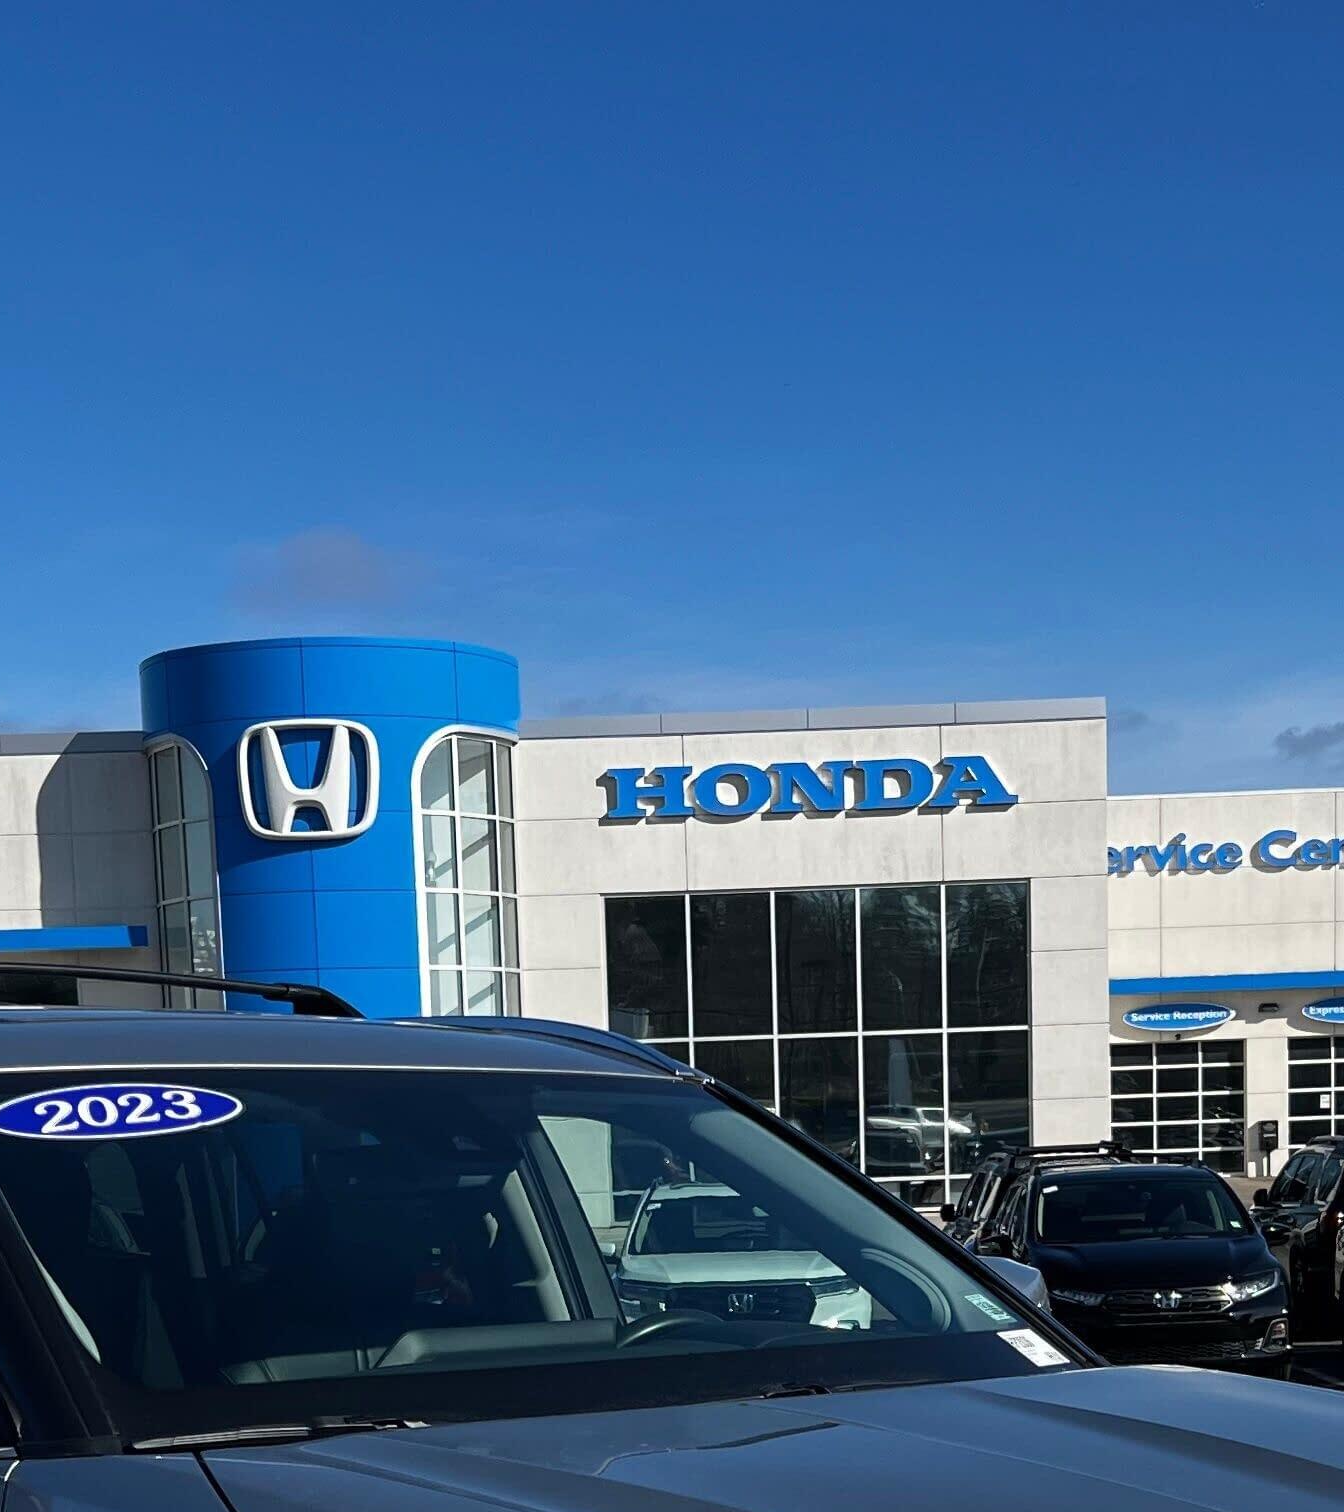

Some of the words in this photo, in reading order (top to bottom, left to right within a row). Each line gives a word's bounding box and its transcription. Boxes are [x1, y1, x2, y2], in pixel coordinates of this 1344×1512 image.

[606, 755, 1019, 819] HONDA
[1107, 832, 1243, 873] ervice
[1131, 1012, 1170, 1022] Service
[1173, 1009, 1227, 1022] Reception
[34, 1090, 203, 1134] 2023
